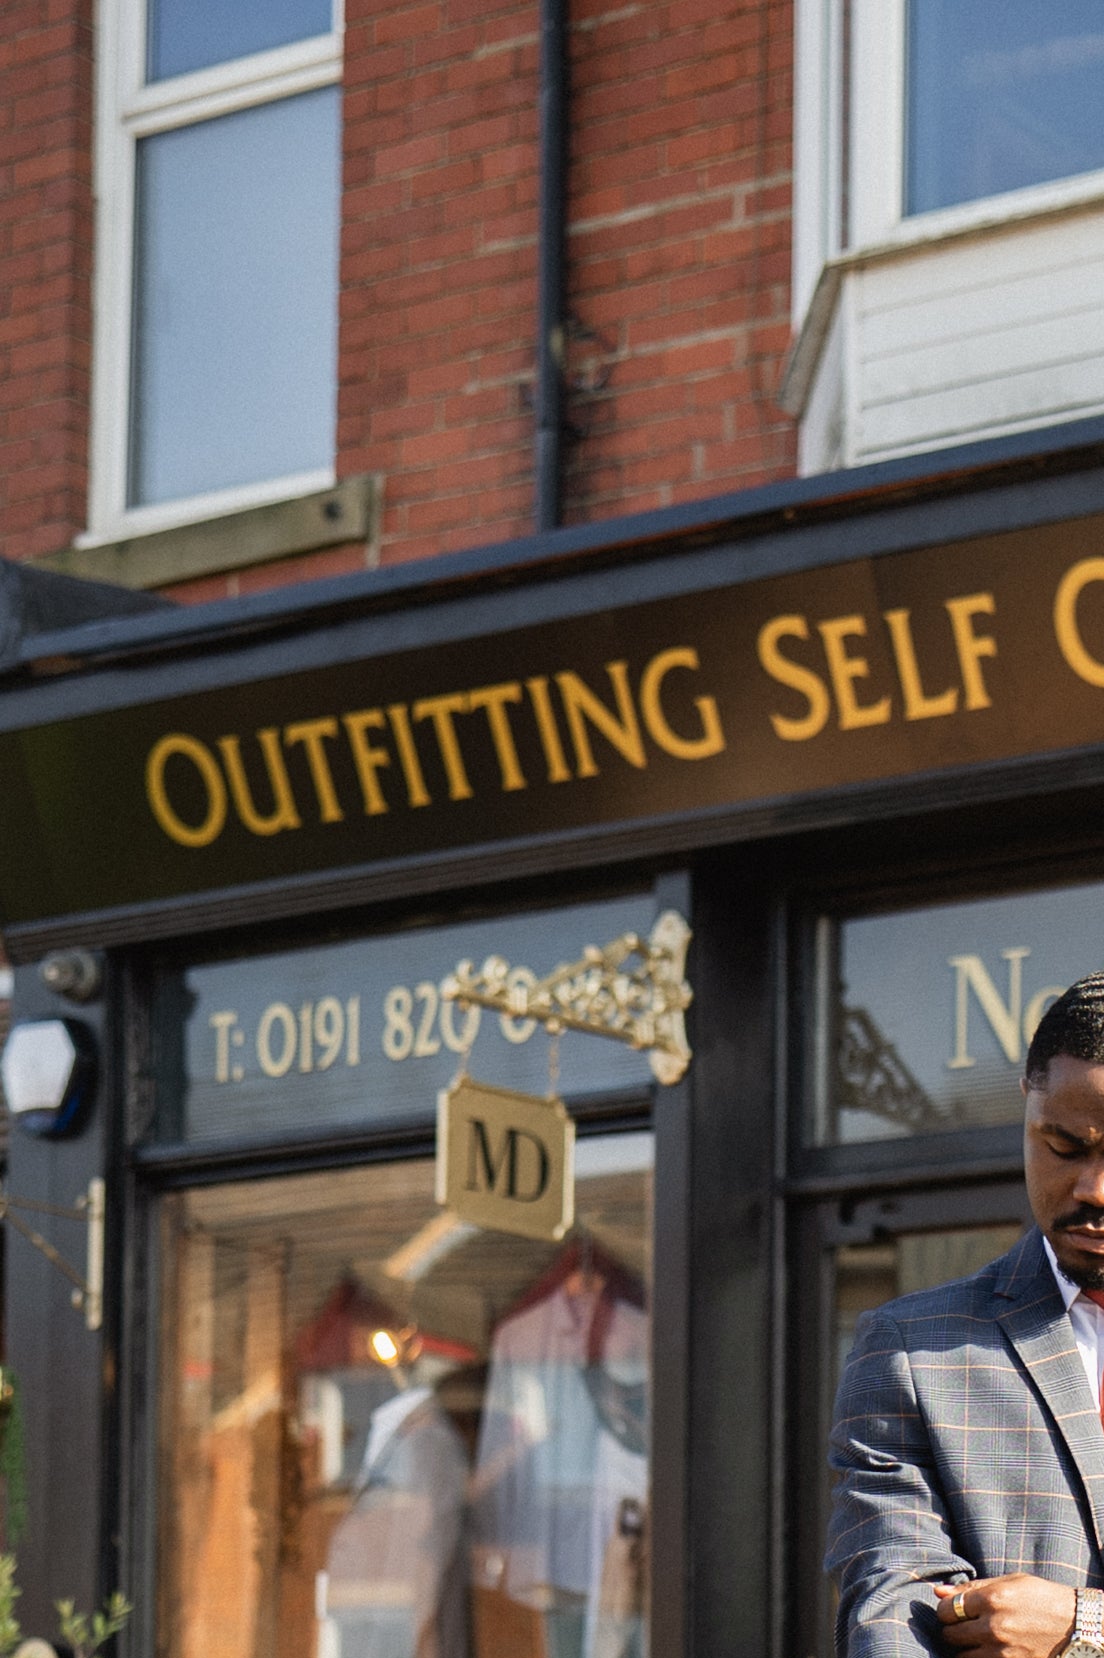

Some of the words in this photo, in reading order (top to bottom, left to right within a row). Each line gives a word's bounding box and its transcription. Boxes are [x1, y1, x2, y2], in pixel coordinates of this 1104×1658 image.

[145, 646, 727, 847] OUTFITTING
[756, 591, 998, 742] SELF
[209, 1010, 245, 1084] T:
[256, 996, 362, 1078] 0191
[465, 1116, 550, 1204] MD
